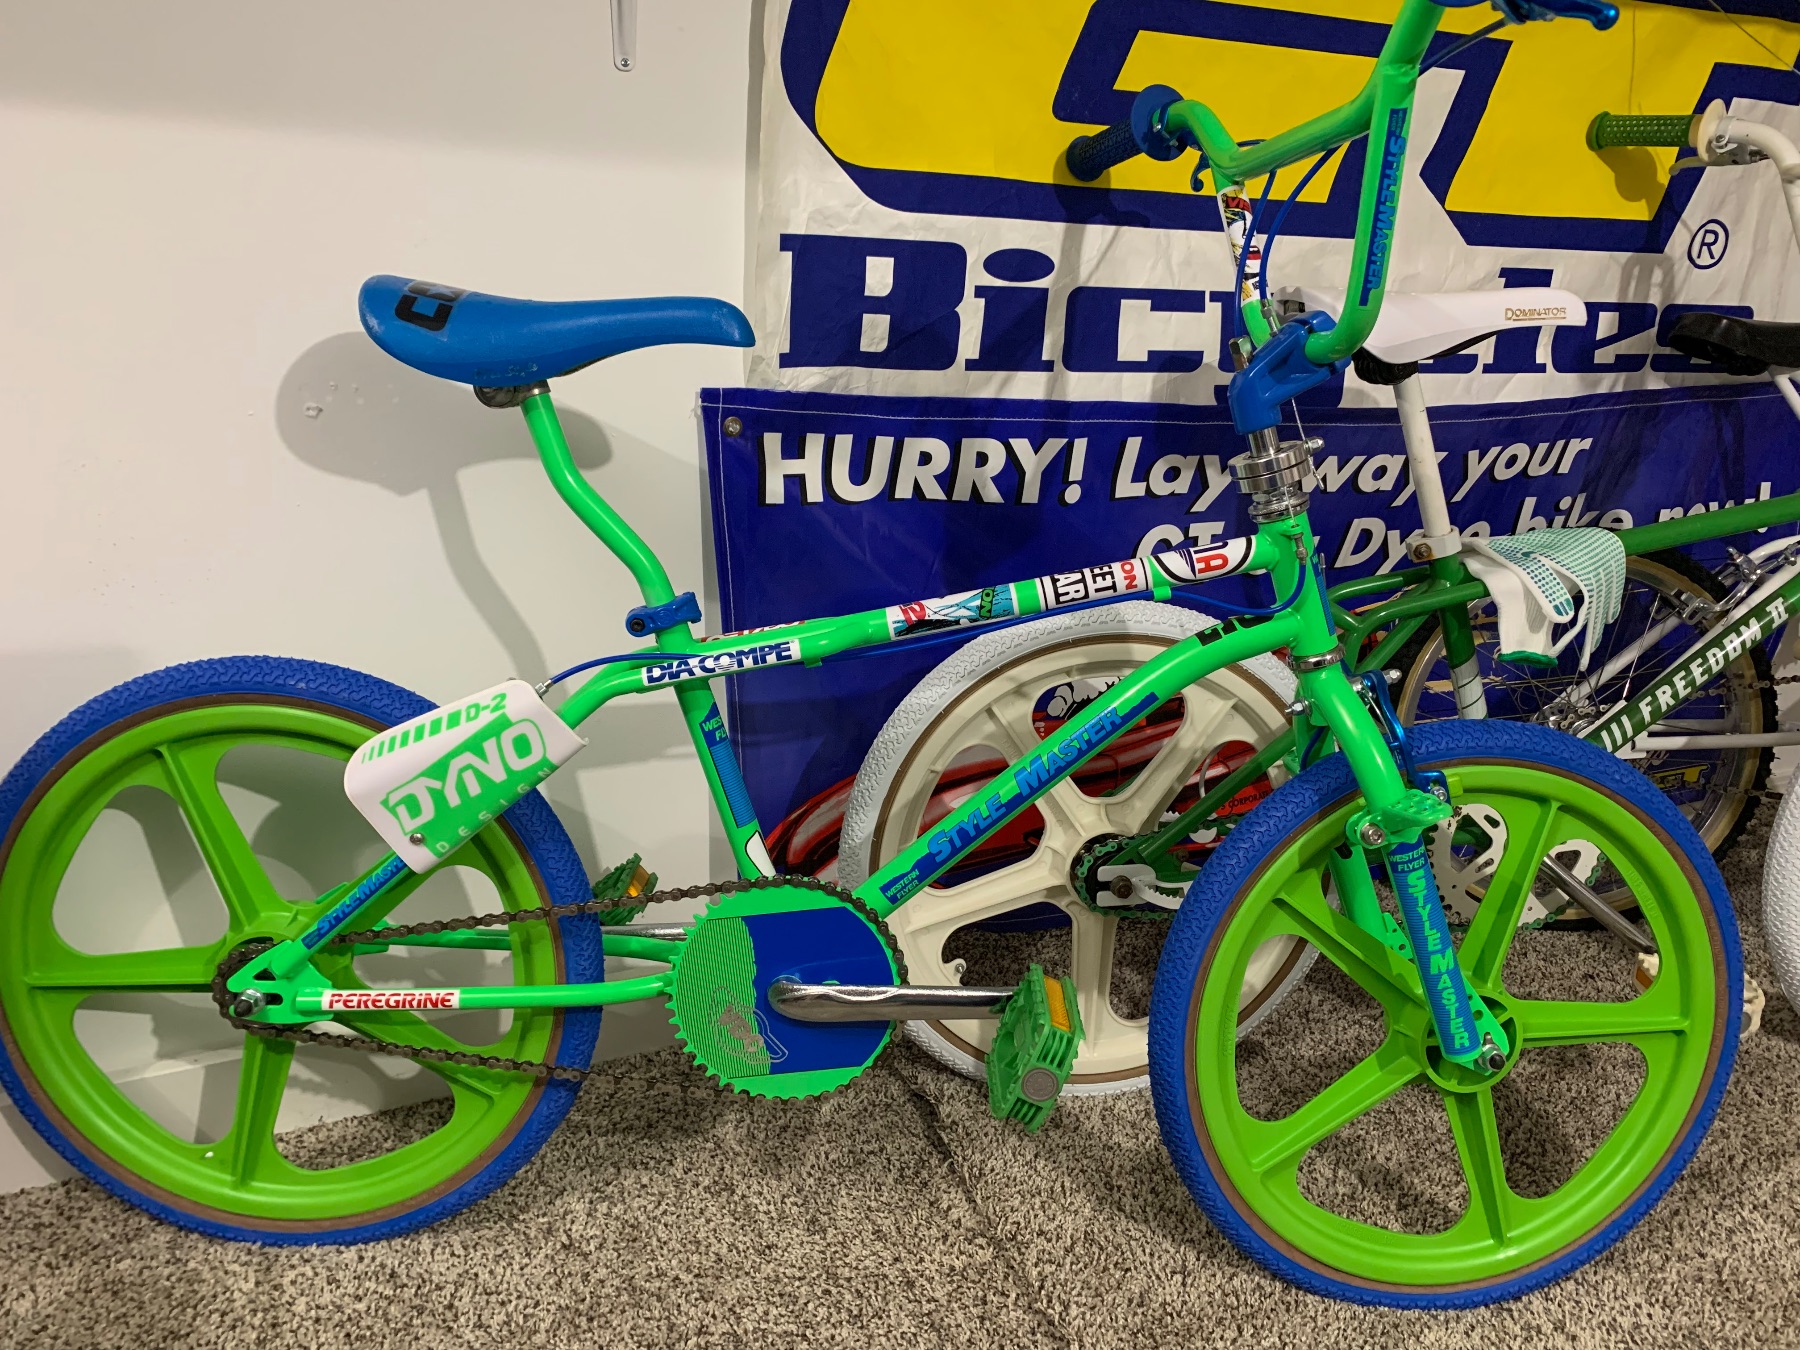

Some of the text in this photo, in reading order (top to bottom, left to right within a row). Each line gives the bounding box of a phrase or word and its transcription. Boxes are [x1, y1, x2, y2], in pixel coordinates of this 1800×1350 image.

[779, 233, 1756, 409] Bicle
[1504, 307, 1567, 321] DOMINATOR
[762, 432, 1594, 513] HURRY! Laywa your
[646, 641, 793, 685] DIA-COMPE
[1638, 617, 1763, 726] FREEDOM
[464, 692, 508, 723] D-2
[387, 720, 546, 835] DYNO
[926, 706, 1123, 864] STYLE MASTER
[436, 767, 551, 854] DESIGN
[885, 868, 920, 900] WESTERN
[896, 880, 920, 901] FLYER
[1397, 857, 1426, 872] FLYER
